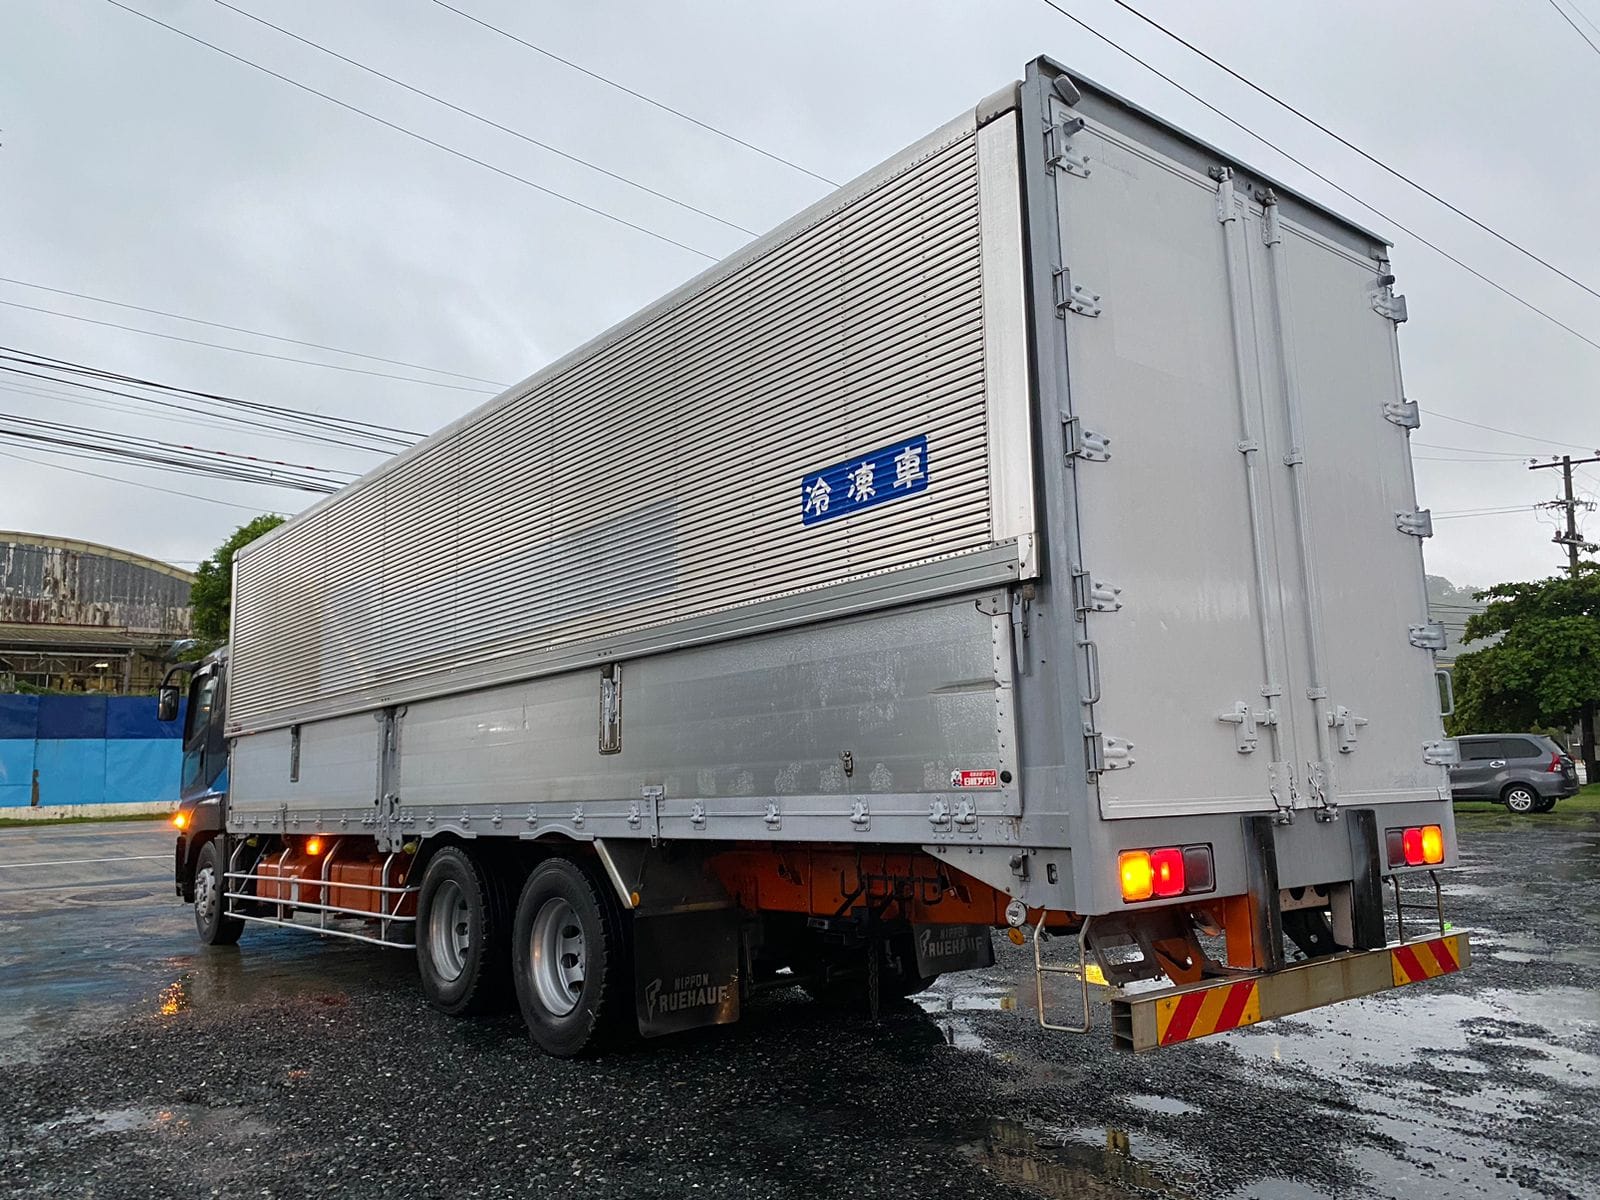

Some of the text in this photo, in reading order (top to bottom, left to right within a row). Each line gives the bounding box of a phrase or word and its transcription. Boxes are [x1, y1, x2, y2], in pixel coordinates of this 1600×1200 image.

[804, 446, 925, 516] 冷凍車
[674, 973, 709, 990] NIPPON
